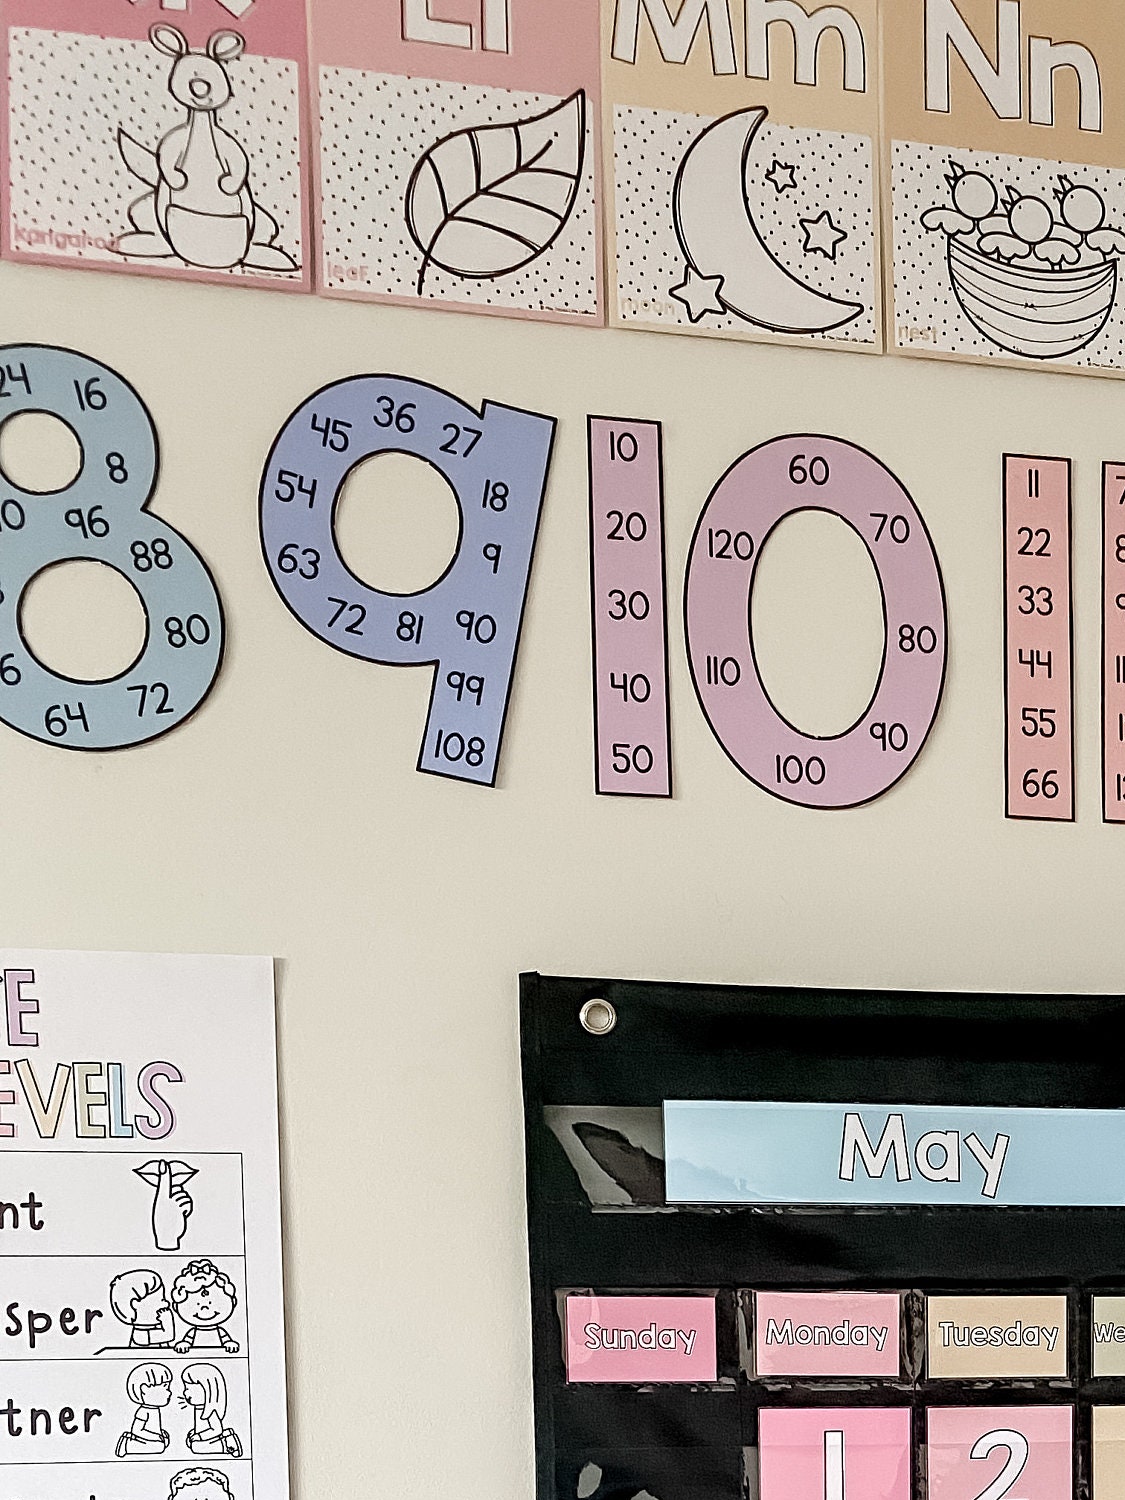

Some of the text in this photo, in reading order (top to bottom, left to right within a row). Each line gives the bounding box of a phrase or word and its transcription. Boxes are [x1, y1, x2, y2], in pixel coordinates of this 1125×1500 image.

[925, 0, 1102, 133] Nn
[75, 377, 107, 410] 16
[373, 396, 416, 433] 36
[311, 415, 350, 452] 45
[440, 423, 483, 457] 27
[609, 432, 638, 461] 10
[106, 452, 128, 484] 8
[788, 455, 830, 485] 60
[1027, 469, 1039, 498] 11
[275, 470, 317, 508] 54
[483, 480, 509, 511] 18
[66, 507, 110, 539] 96
[606, 511, 647, 541] 20
[869, 513, 910, 543] 70
[129, 538, 173, 572] 88
[708, 530, 754, 559] 120
[1017, 528, 1052, 556] 22
[278, 544, 321, 579] 63
[483, 543, 502, 573] 9
[327, 598, 367, 635] 72
[607, 590, 650, 620] 30
[1017, 587, 1054, 615] 33
[164, 613, 210, 647] 80
[396, 612, 423, 643] 81
[456, 610, 497, 643] 90
[898, 625, 936, 653] 80
[706, 656, 741, 686] 110
[1018, 649, 1053, 678] 44
[127, 683, 173, 716] 72
[446, 671, 486, 705] 99
[610, 673, 651, 702] 40
[45, 702, 89, 737] 64
[1021, 708, 1057, 737] 55
[434, 730, 486, 765] 108
[870, 723, 908, 752] 90
[612, 744, 654, 773] 50
[775, 754, 826, 785] 100
[1022, 769, 1059, 799] 66
[839, 1112, 1010, 1198] May
[6, 1302, 103, 1348] sper
[584, 1323, 697, 1355] Sunday
[766, 1319, 888, 1351] Monday
[939, 1321, 1059, 1351] Tuesday
[0, 1399, 102, 1436] tner
